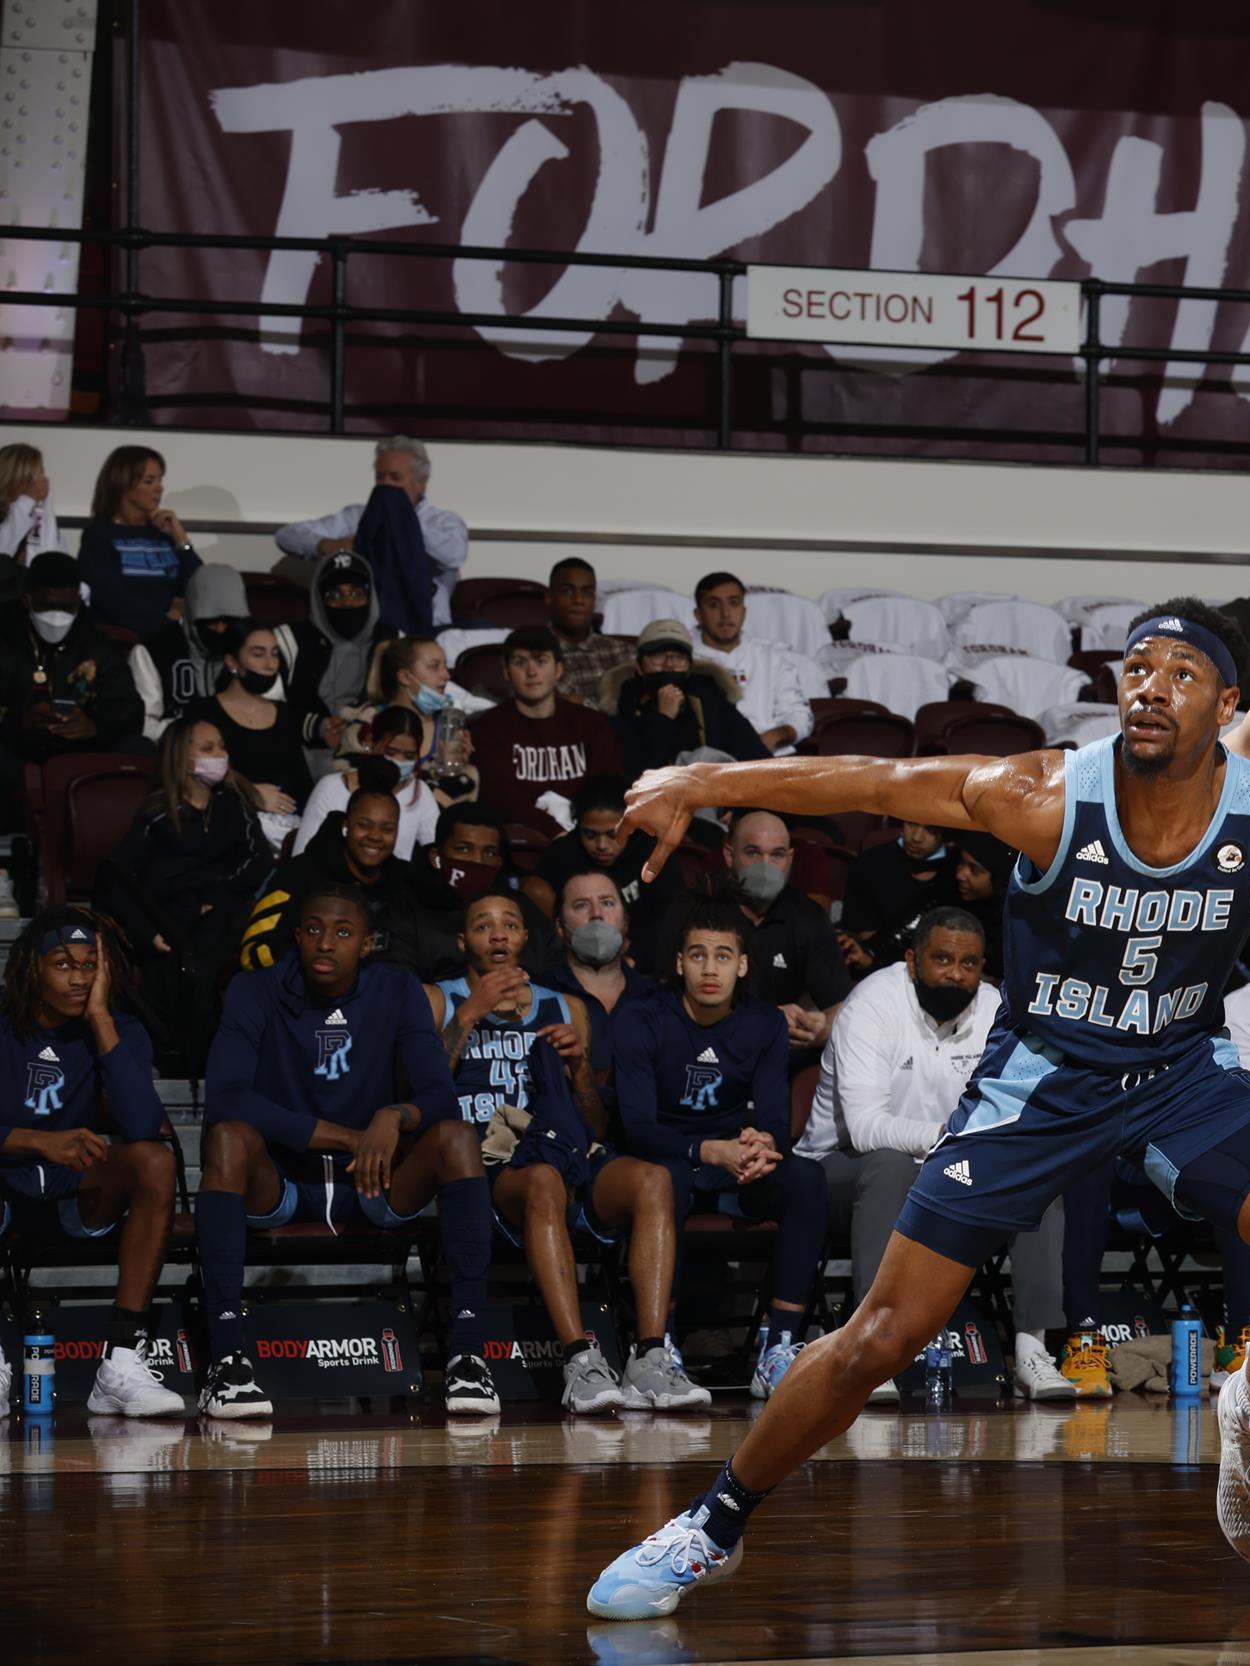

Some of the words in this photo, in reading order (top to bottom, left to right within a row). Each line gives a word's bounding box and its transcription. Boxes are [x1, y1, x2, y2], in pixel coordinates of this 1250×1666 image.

[783, 288, 933, 324] SECTION
[957, 286, 1046, 342] 112
[1075, 851, 1109, 865] adidas
[448, 867, 466, 888] F
[1065, 876, 1235, 932] RHODE
[1118, 935, 1163, 986] 5
[1027, 972, 1209, 1035] ISLAND
[944, 1167, 973, 1186] adidas
[53, 1338, 173, 1361] BODYOR
[256, 1337, 378, 1359] BODYARMOR
[317, 1358, 350, 1368] Sports
[352, 1356, 379, 1366] Drink
[1189, 1331, 1198, 1385] POWERADE
[31, 1346, 41, 1402] PORADE
